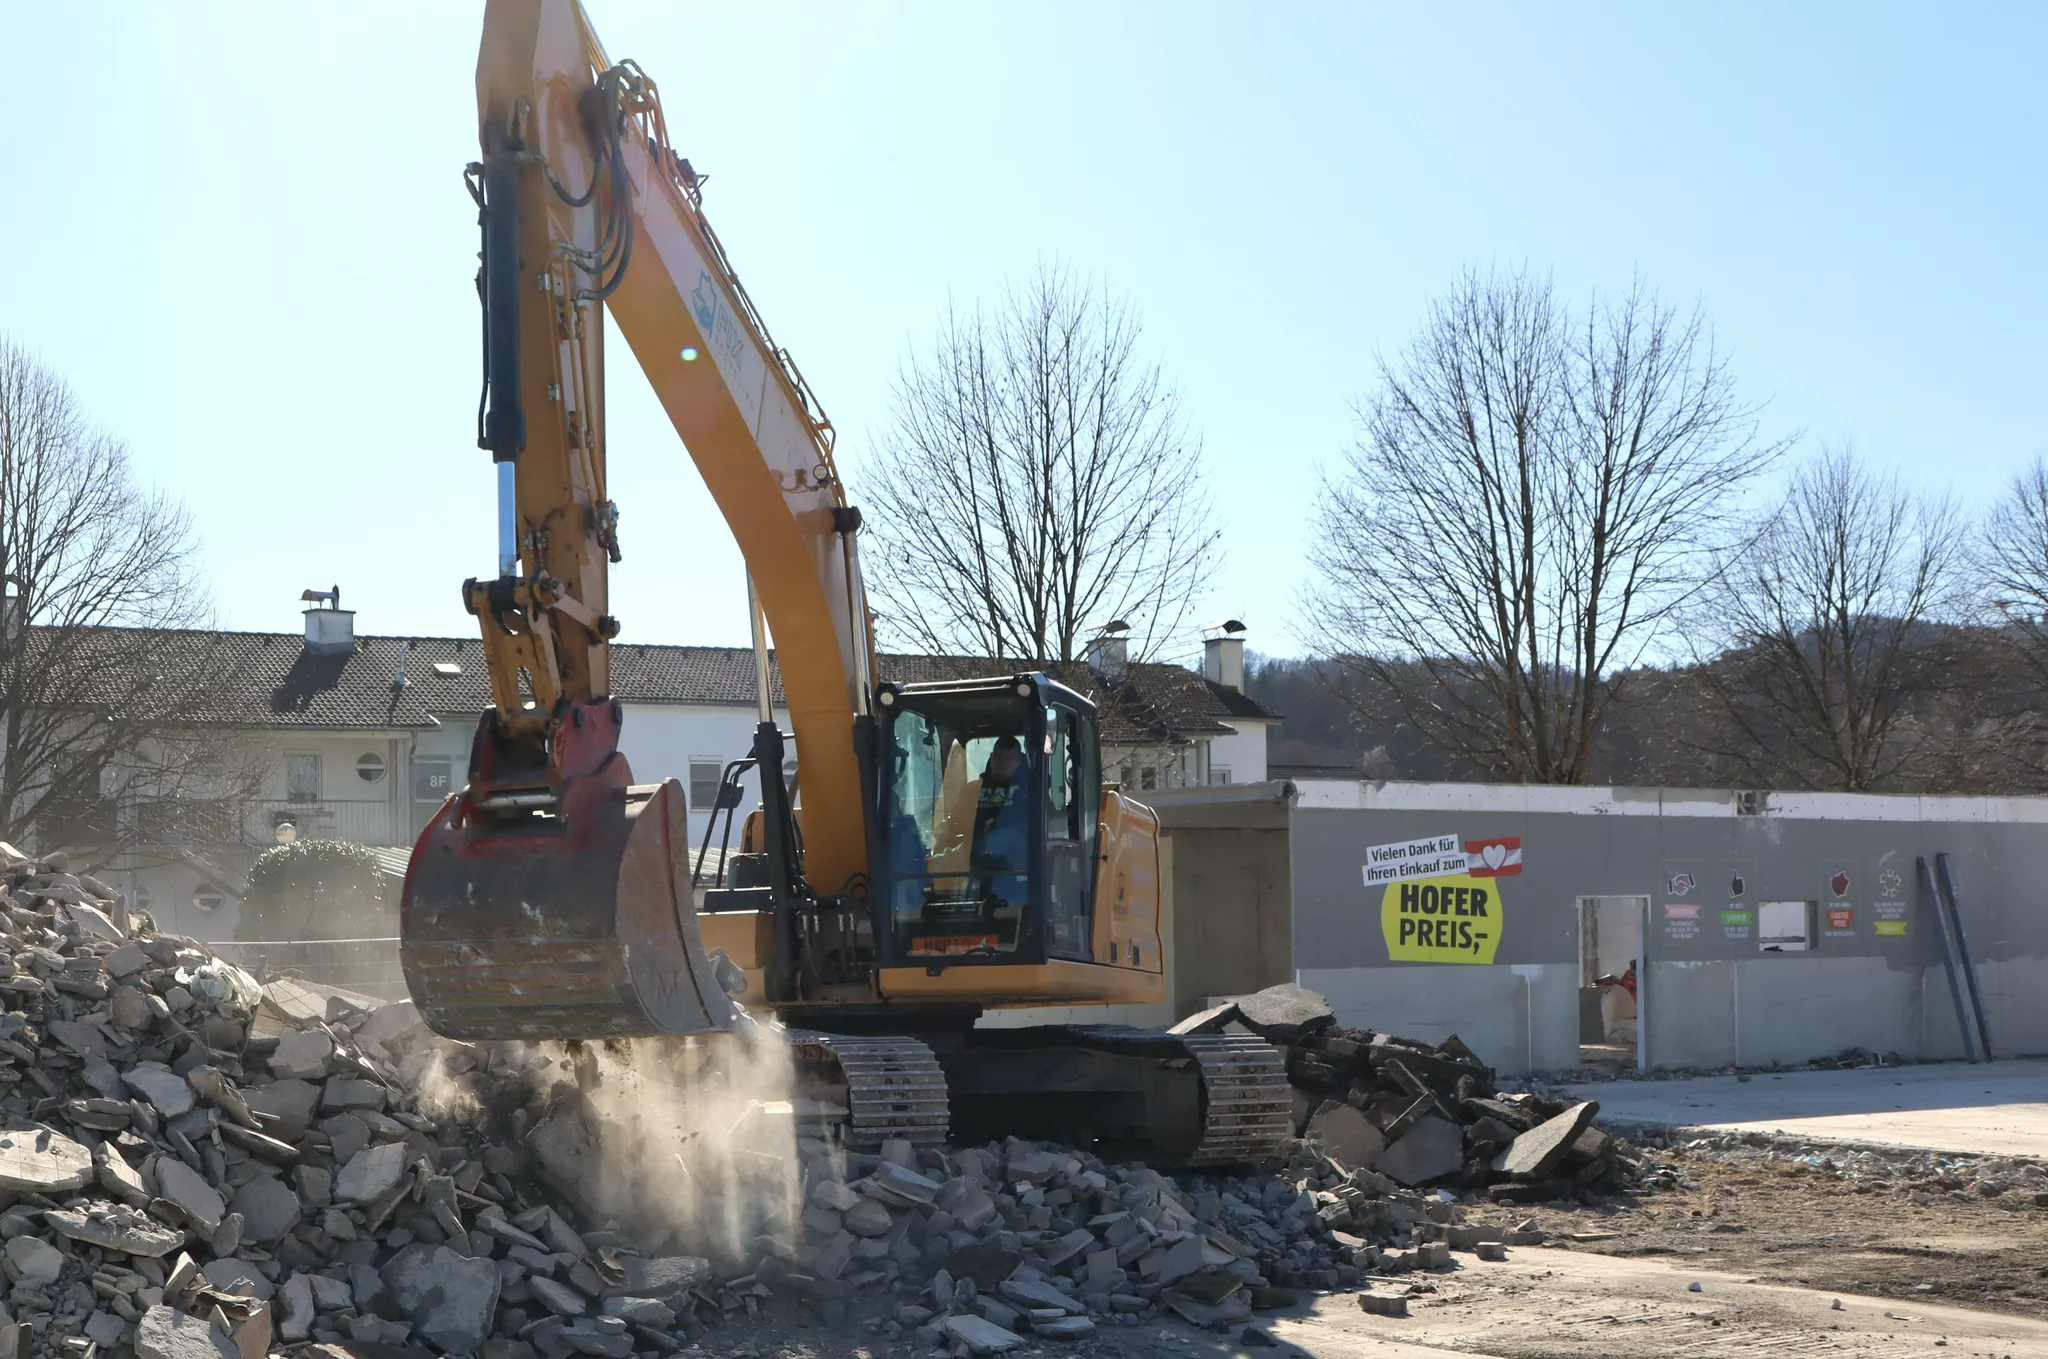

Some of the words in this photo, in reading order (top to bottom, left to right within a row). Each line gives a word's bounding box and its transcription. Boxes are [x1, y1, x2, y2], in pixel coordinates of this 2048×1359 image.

[430, 775, 448, 788] 8F
[1371, 847, 1406, 862] Vielen
[1409, 840, 1437, 856] Dank
[1439, 838, 1455, 852] für
[1367, 867, 1397, 881] Ihren
[1400, 859, 1440, 876] Einkauf
[1443, 858, 1466, 871] zum
[1400, 884, 1488, 917] HOFER
